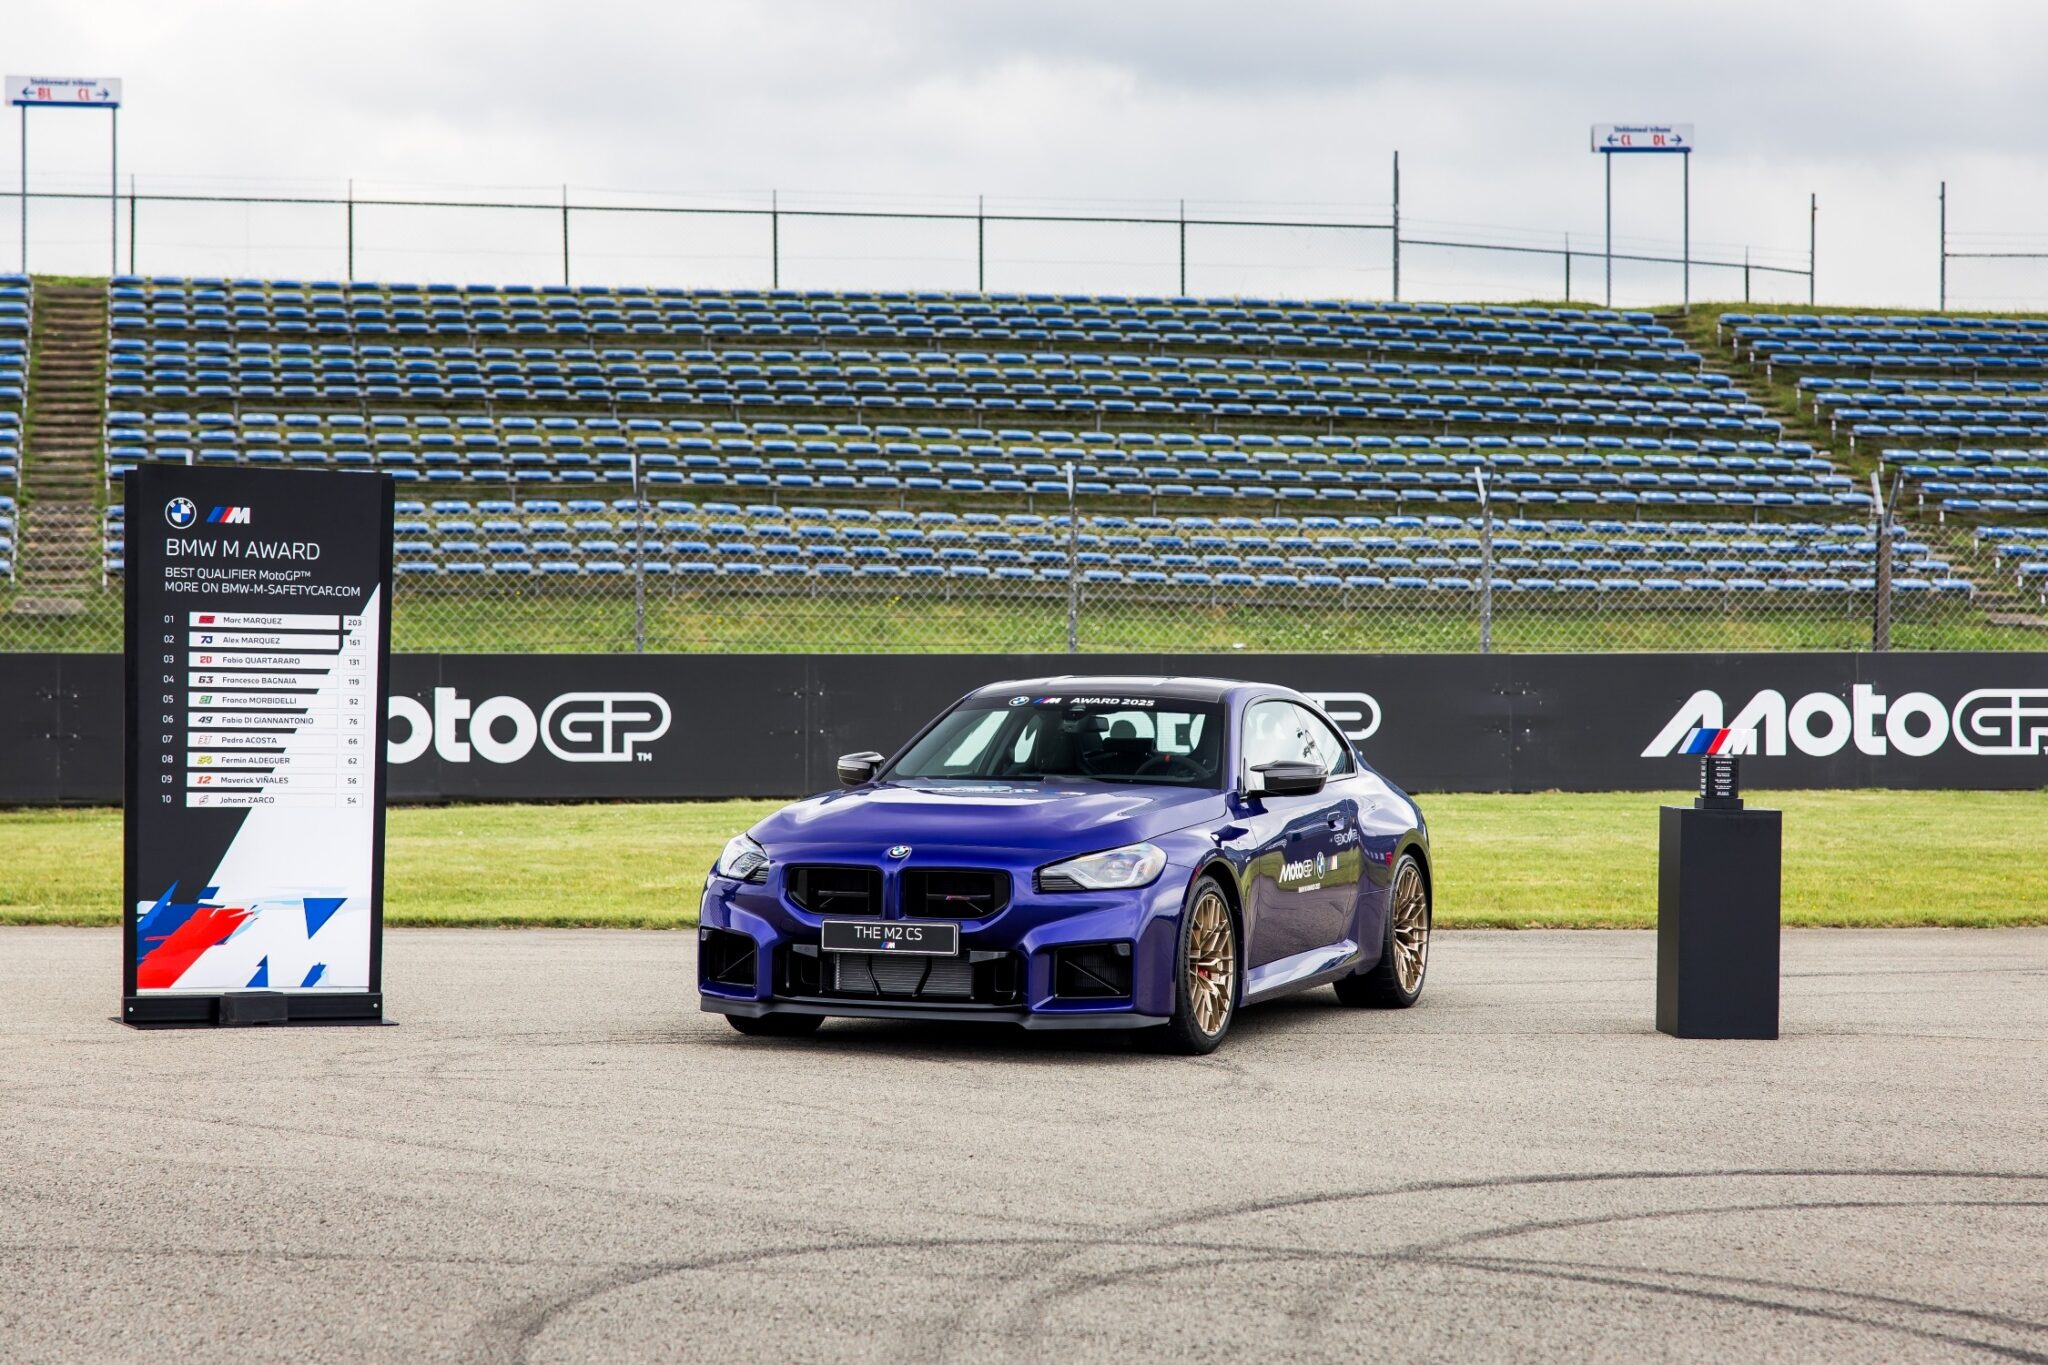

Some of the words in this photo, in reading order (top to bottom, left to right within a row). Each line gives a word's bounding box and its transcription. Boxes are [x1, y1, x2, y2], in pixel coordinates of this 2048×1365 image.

[166, 539, 216, 557] BMW
[223, 541, 239, 558] M
[245, 541, 320, 560] AWARD
[165, 567, 193, 578] BEST
[197, 568, 256, 580] QUALIFIER
[165, 582, 198, 592] MORE
[202, 583, 218, 593] ON
[222, 583, 360, 597] BMW-M-SAFETYCAR.COM
[164, 615, 174, 623] 01
[223, 616, 241, 624] Marc
[243, 617, 282, 625] MARQUEZ
[164, 635, 174, 643] 02
[223, 636, 240, 644] Alex
[241, 636, 280, 645] MARQUEZ
[163, 655, 174, 663] 03
[223, 656, 243, 664] Fabio
[245, 657, 300, 665] QUARTARARO
[163, 675, 174, 683] 04
[198, 676, 214, 684] 63
[222, 676, 260, 684] Francesco
[261, 677, 297, 685] BAGNAIA
[348, 678, 359, 686] 119
[163, 695, 174, 704] 05
[222, 696, 247, 704] Franco
[249, 696, 297, 705] MORBIDELLI
[1070, 697, 1120, 705] AWARD
[1121, 698, 1155, 706] 2025
[162, 715, 173, 723] 06
[198, 716, 213, 724] 49
[253, 717, 314, 725] GIANNANTONIO
[387, 687, 671, 764] otoGP
[162, 735, 173, 744] 07
[221, 736, 243, 744] Pedro
[245, 736, 277, 745] ACOSTA
[161, 755, 173, 764] 08
[248, 757, 290, 765] ALDEGUER
[161, 775, 173, 783] 09
[197, 776, 212, 784] 12
[220, 776, 254, 784] Maverick
[256, 775, 289, 785] VIÑALES
[347, 777, 357, 785] 56
[162, 795, 171, 803] 10
[220, 796, 247, 804] Johann
[248, 796, 275, 804] ZARCO
[1279, 859, 1313, 883] MotoGP
[854, 926, 881, 939] THE
[884, 927, 903, 940] M2
[905, 928, 923, 941] CS
